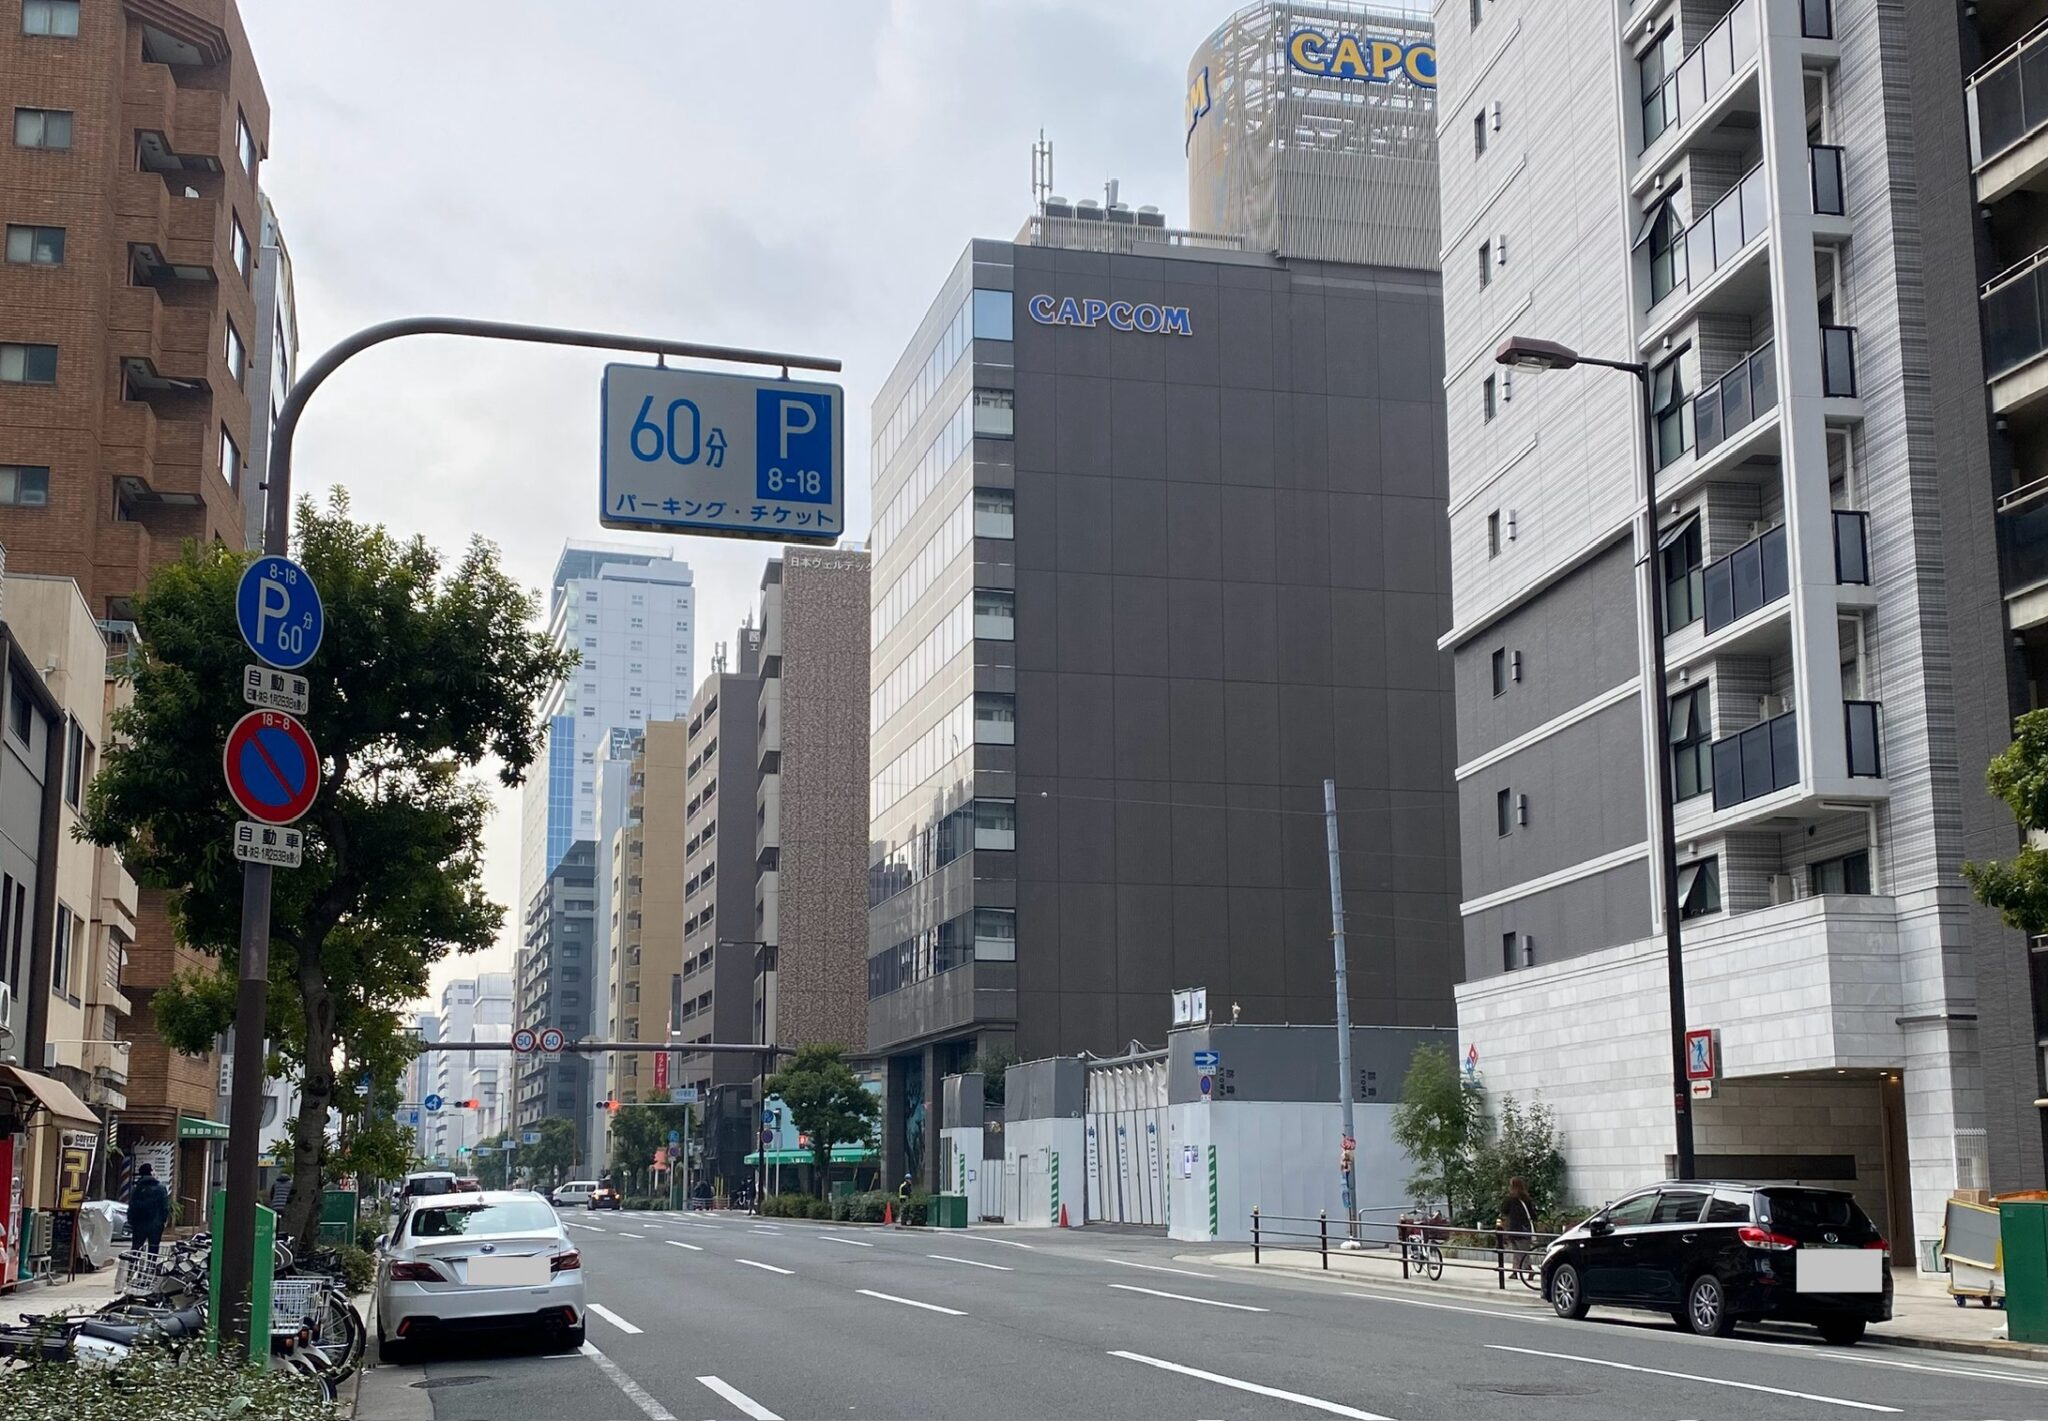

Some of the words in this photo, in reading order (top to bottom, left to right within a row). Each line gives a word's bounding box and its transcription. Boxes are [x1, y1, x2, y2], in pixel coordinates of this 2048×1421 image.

[1288, 31, 1437, 86] CAPC
[1029, 294, 1192, 335] CAPCOM
[631, 395, 727, 468] 60分
[780, 399, 817, 459] P
[768, 467, 821, 494] 8-18
[616, 494, 833, 527] パーキング・チケット
[270, 563, 297, 585] 8-18
[257, 577, 290, 644] P
[249, 670, 306, 696] 自動車
[262, 713, 290, 730] 18-8
[240, 826, 299, 848] 自動車
[517, 1035, 531, 1046] 50
[545, 1034, 559, 1046] 60
